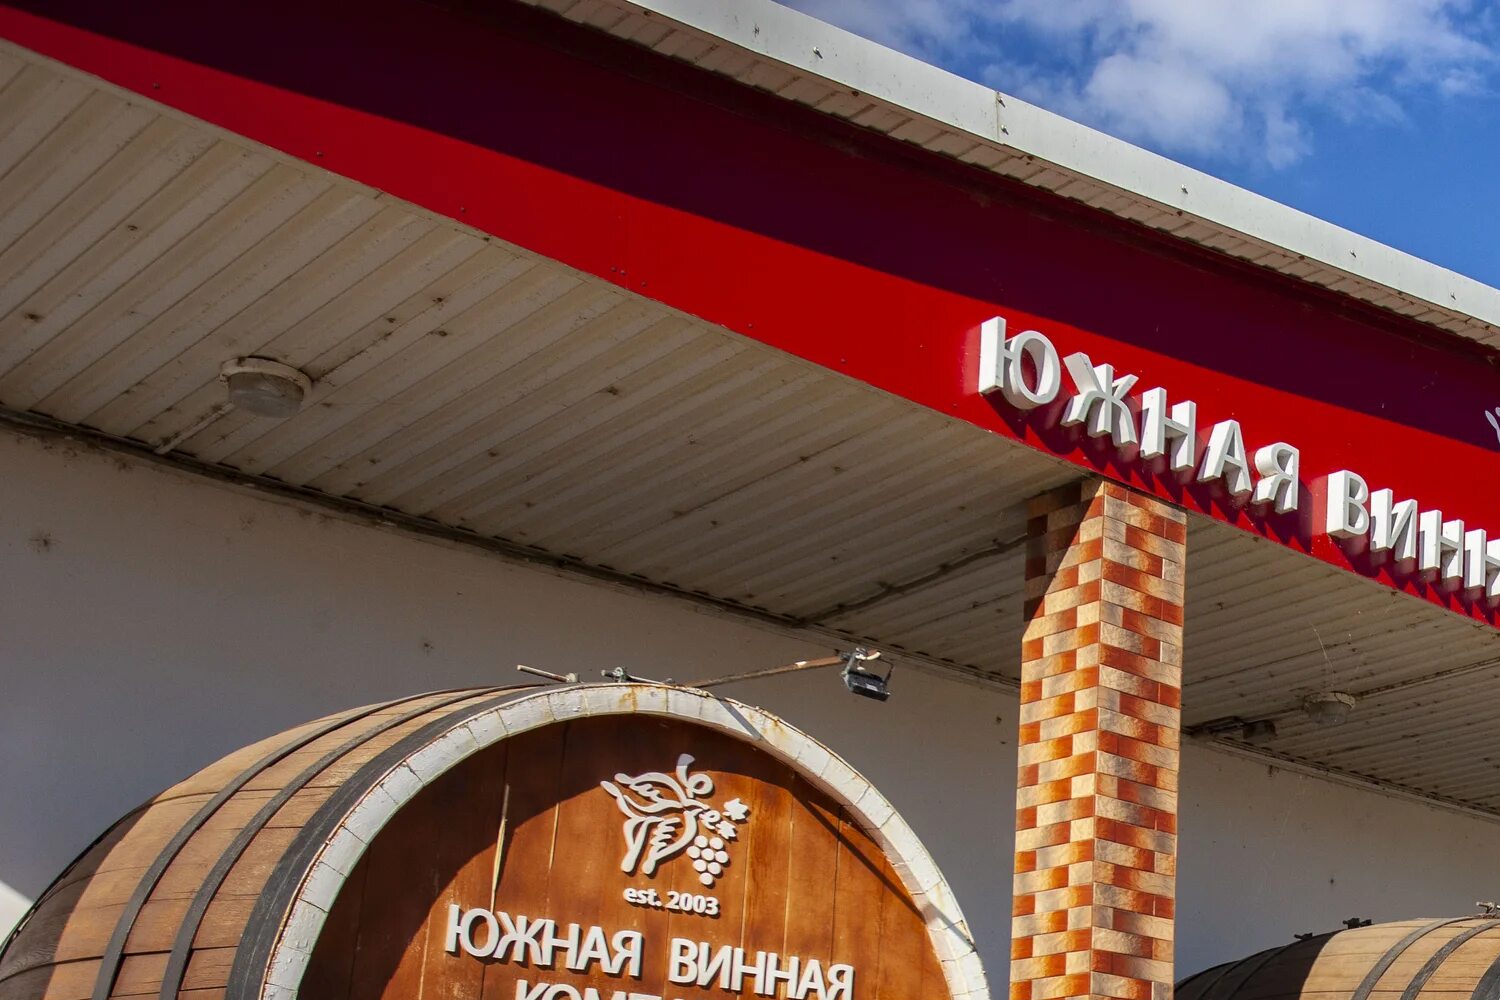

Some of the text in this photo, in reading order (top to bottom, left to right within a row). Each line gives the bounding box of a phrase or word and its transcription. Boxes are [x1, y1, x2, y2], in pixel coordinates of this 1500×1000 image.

[979, 316, 1299, 515] ЮЖНАЯ
[623, 888, 719, 915] est. 2003
[444, 904, 642, 977] ЮЖНАЯ
